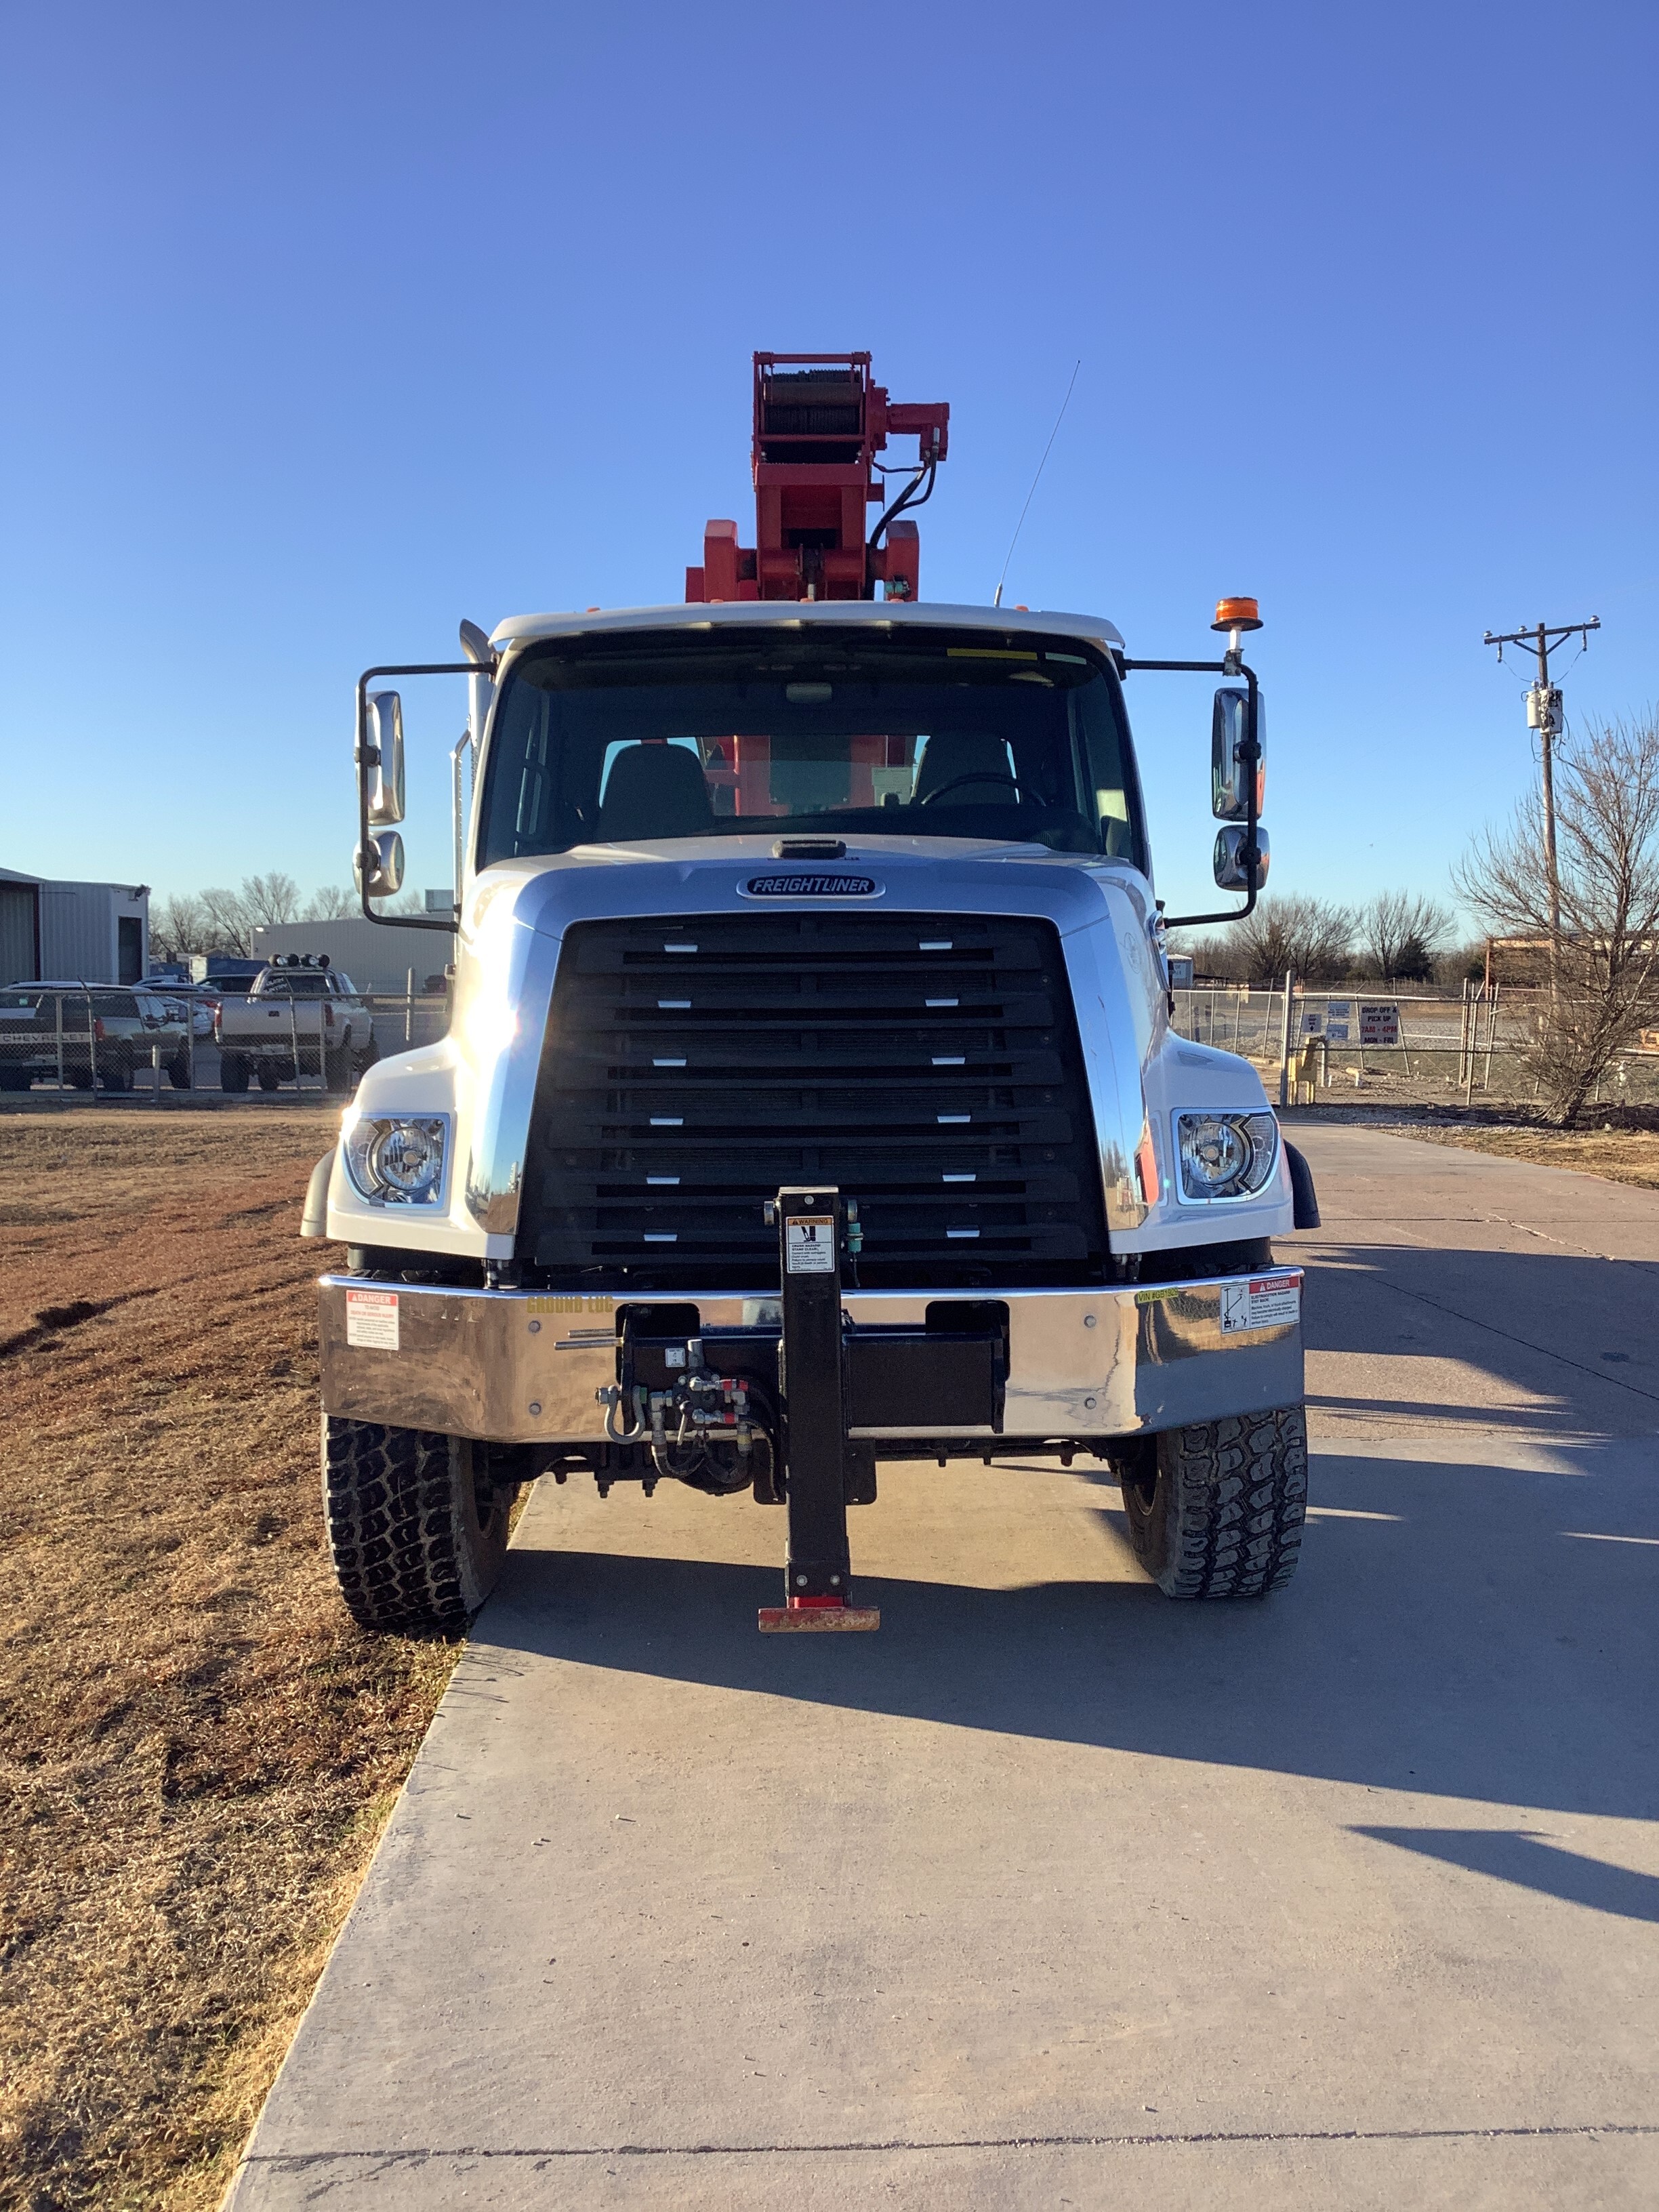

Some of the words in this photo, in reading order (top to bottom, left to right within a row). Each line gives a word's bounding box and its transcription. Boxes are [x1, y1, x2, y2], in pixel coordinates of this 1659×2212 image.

[753, 878, 869, 892] FREIGHTLINER
[3, 1033, 85, 1042] CHEVROLET
[1267, 1279, 1290, 1290] DANGER
[358, 1294, 391, 1304] DANGER
[1139, 1292, 1150, 1301] VIN
[527, 1296, 583, 1313] GROUND
